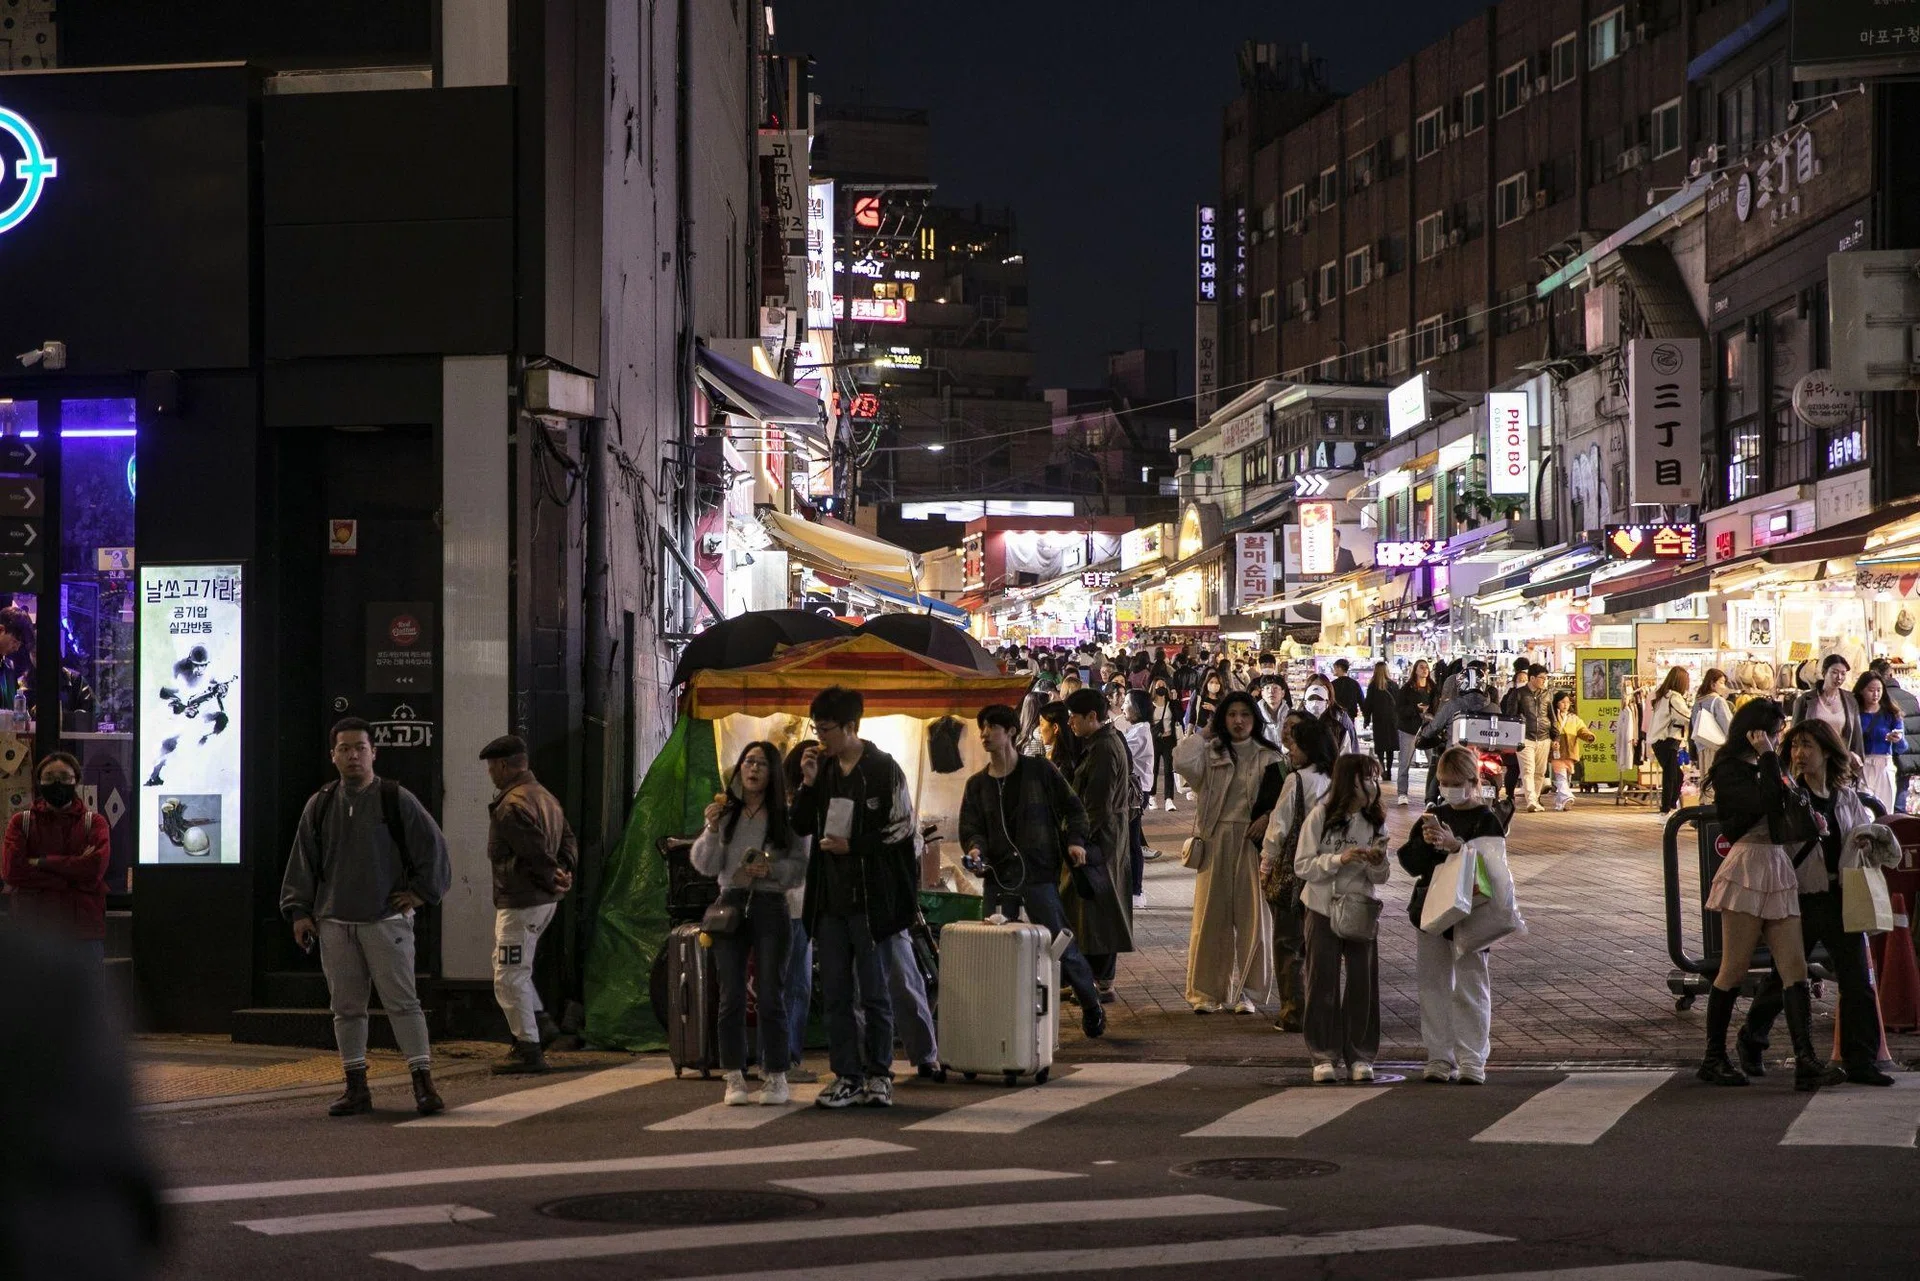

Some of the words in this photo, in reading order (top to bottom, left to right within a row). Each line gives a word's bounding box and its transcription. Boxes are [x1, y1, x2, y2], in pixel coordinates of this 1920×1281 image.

[1860, 25, 1920, 46] 마포구청
[1201, 224, 1217, 299] 호미화방
[1653, 383, 1682, 486] 三丁目
[147, 578, 236, 603] 날쏘고가라
[174, 606, 208, 618] 공기압
[169, 622, 213, 634] 실감반동
[1598, 706, 1620, 717] 신비한
